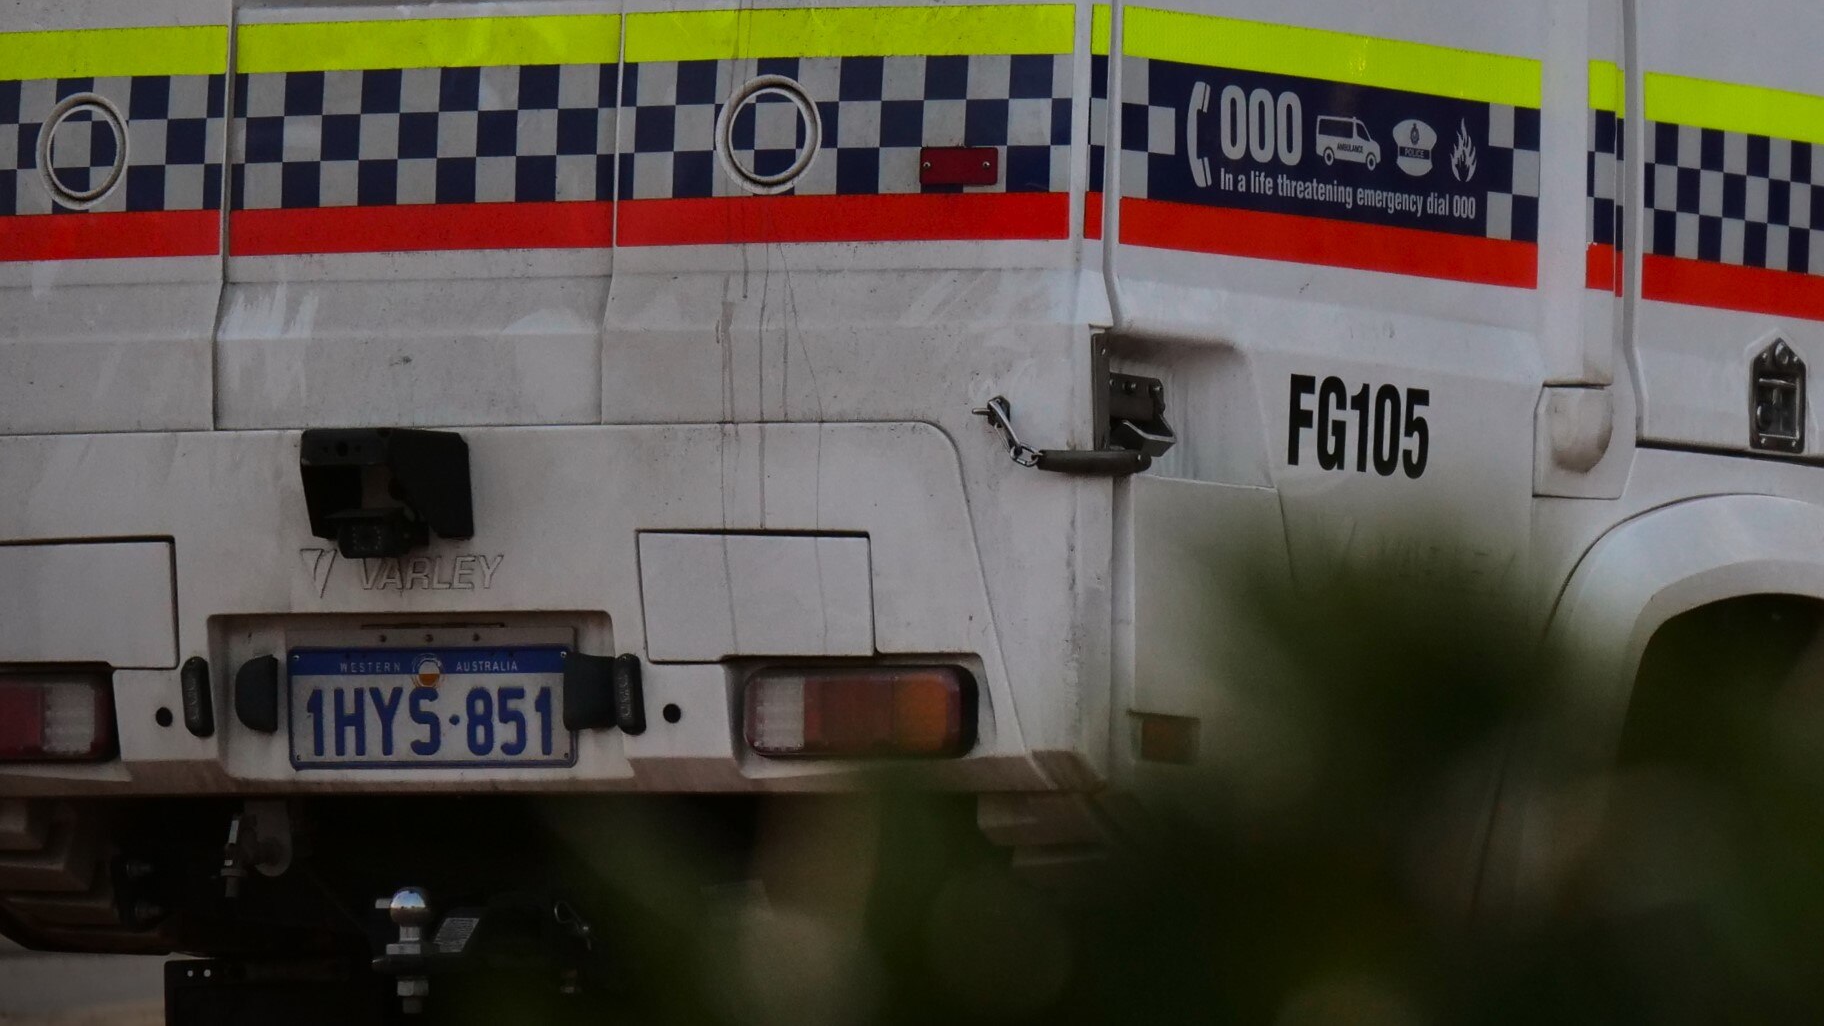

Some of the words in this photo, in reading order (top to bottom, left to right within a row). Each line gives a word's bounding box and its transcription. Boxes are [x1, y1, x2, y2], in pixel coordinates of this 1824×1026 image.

[1220, 84, 1303, 167] 000
[1336, 142, 1364, 155] AMBULANCE
[1404, 147, 1425, 158] POLICE
[1220, 168, 1233, 191] In
[1238, 173, 1246, 190] a
[1250, 171, 1274, 195] life
[1277, 175, 1353, 210] threatening
[1357, 187, 1424, 218] emergency
[1426, 192, 1450, 216] dial
[1453, 195, 1476, 220] 000
[1287, 373, 1430, 480] FG105
[359, 554, 504, 591] VARLEY
[340, 662, 401, 673] WESTERN
[456, 660, 518, 672] AUSTRALIA
